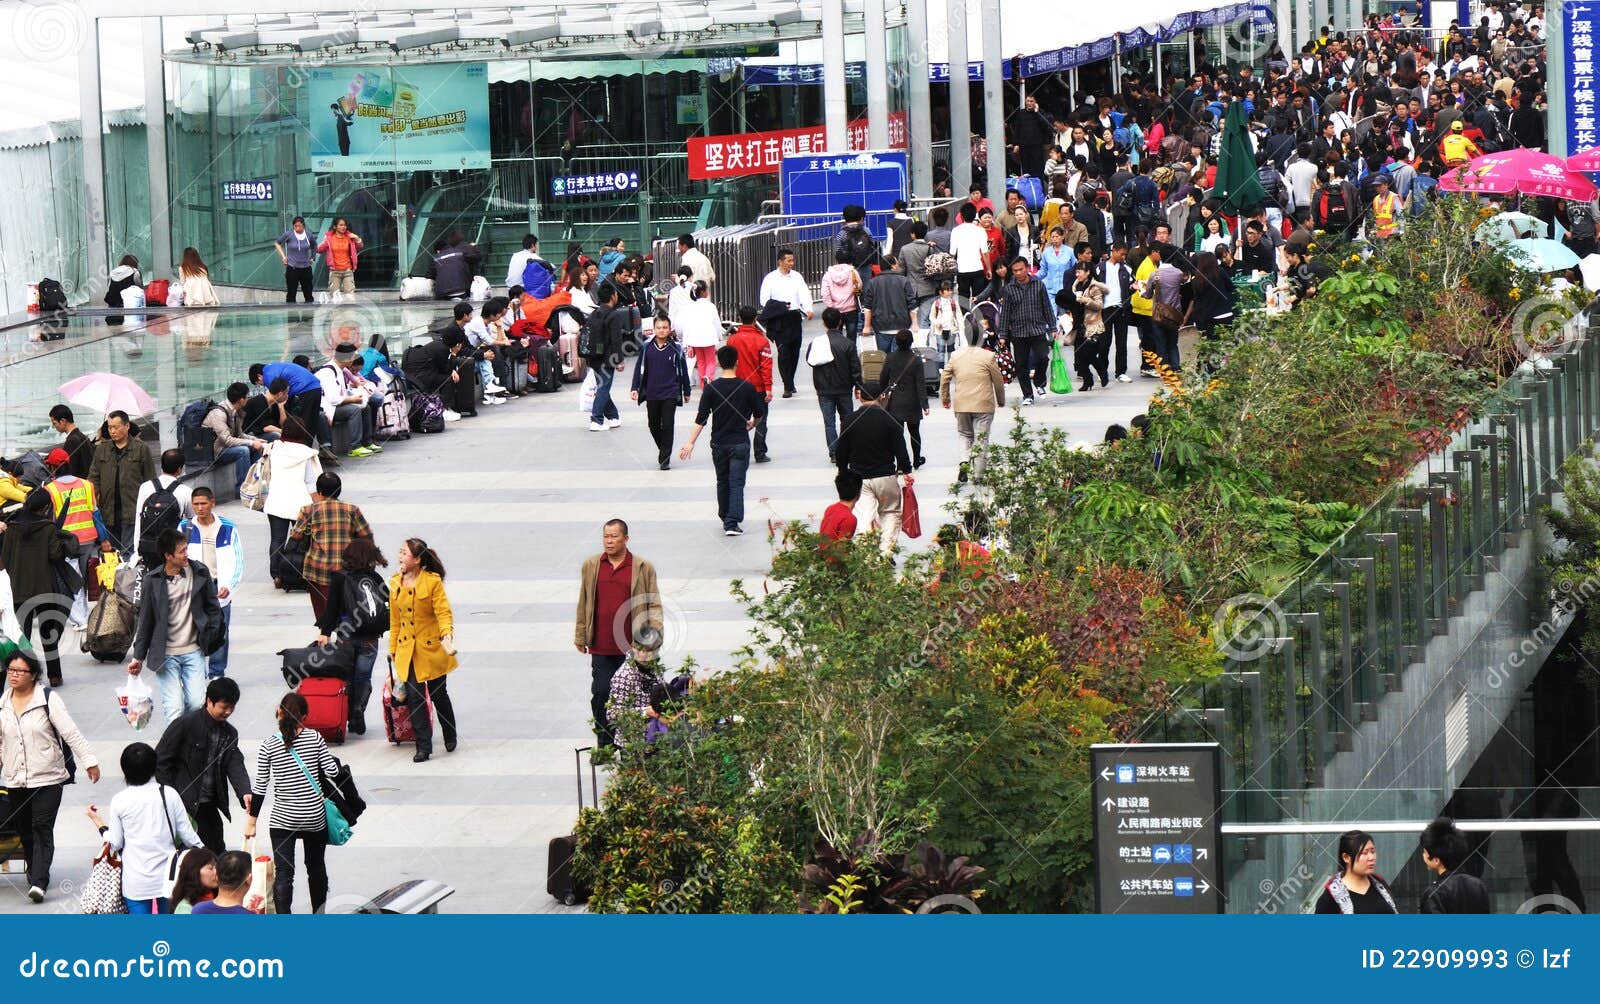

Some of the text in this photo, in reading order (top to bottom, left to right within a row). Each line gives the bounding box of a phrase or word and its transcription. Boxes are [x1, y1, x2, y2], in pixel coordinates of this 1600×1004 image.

[777, 66, 862, 82] 长途车
[704, 133, 825, 171] 坚决打击倒票行
[566, 174, 614, 190] 行李寄存处
[1136, 765, 1190, 777] 深圳火车站
[1117, 797, 1150, 808] 建设路
[1117, 817, 1203, 829] 人民南路商业街区
[1119, 846, 1152, 858] 的士站
[1120, 879, 1174, 890] 公共汽车站
